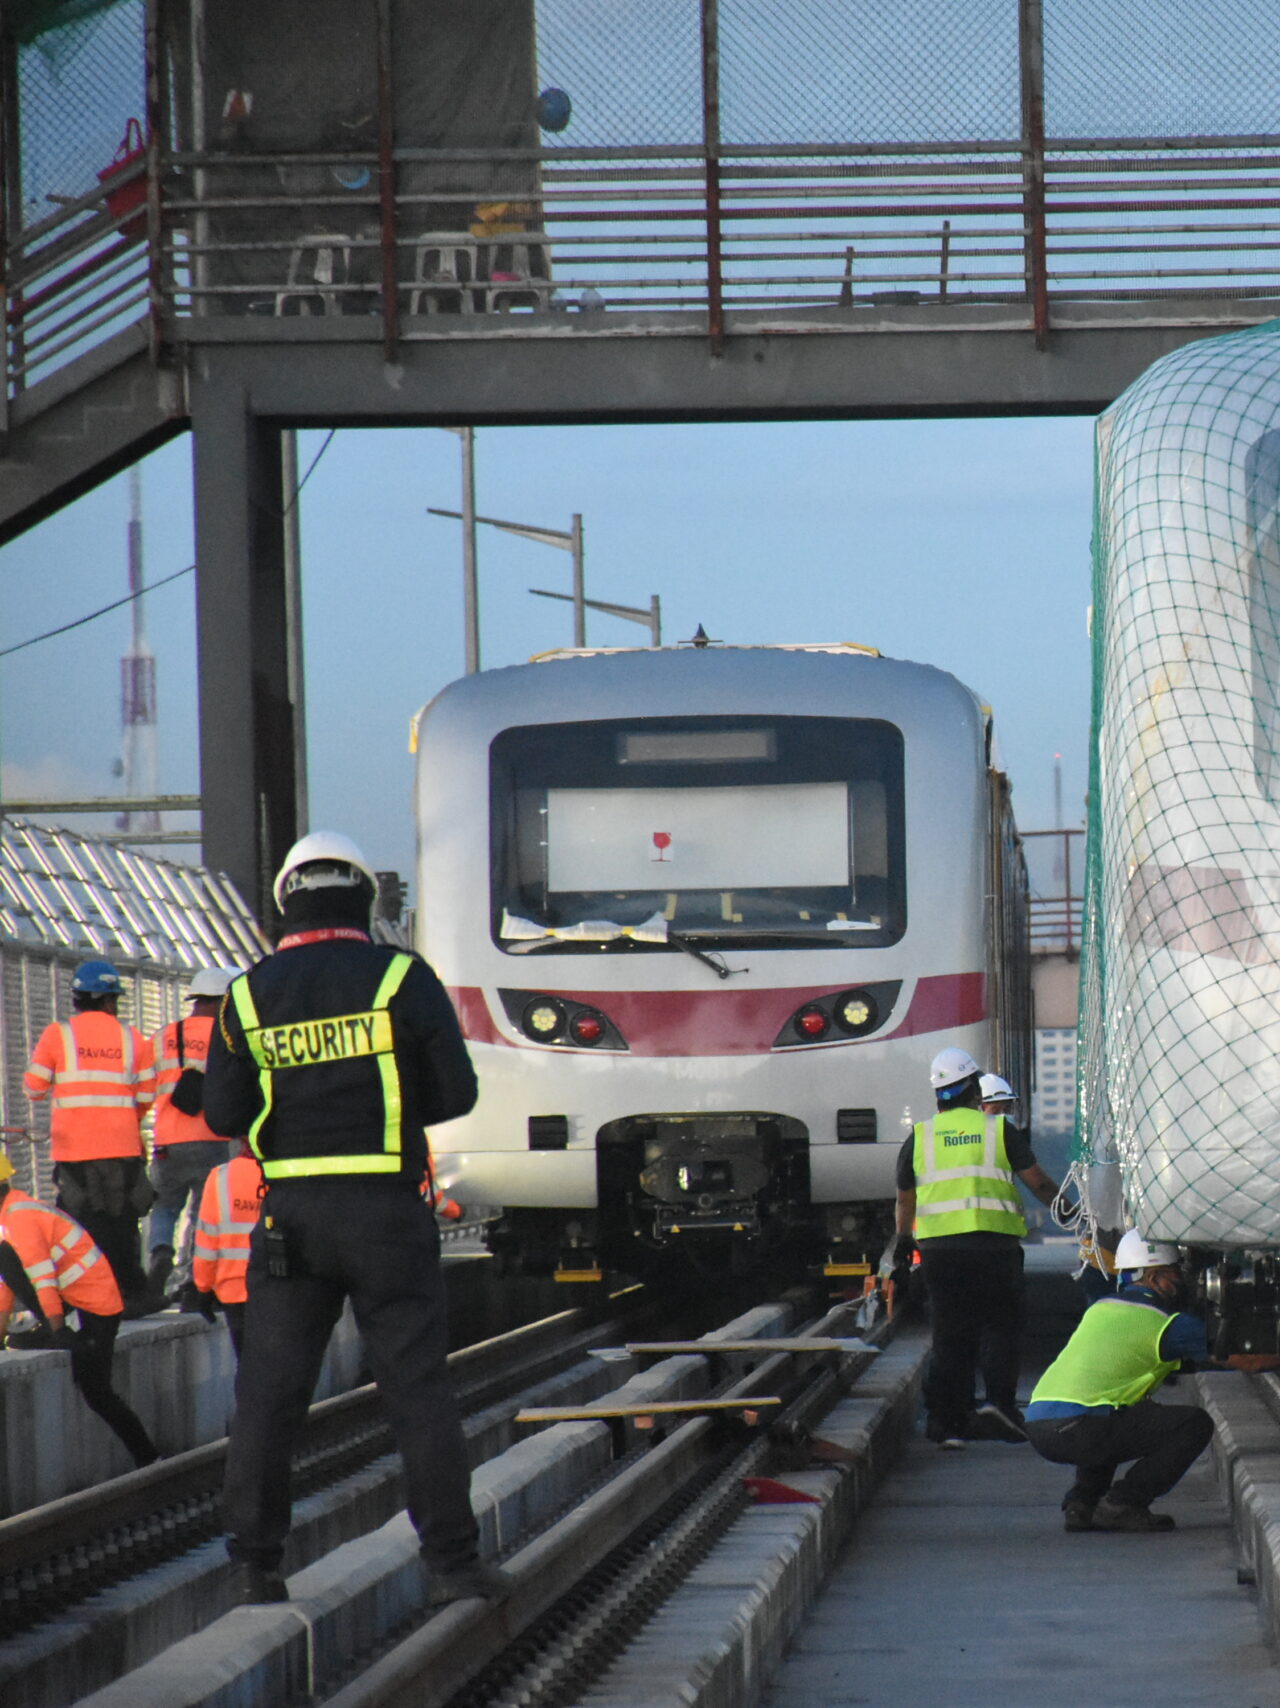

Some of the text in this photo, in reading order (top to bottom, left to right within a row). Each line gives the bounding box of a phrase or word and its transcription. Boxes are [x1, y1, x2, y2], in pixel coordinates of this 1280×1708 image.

[260, 1015, 374, 1067] SECURITY
[78, 1047, 123, 1059] RAVAGO
[944, 1131, 982, 1147] Rotem
